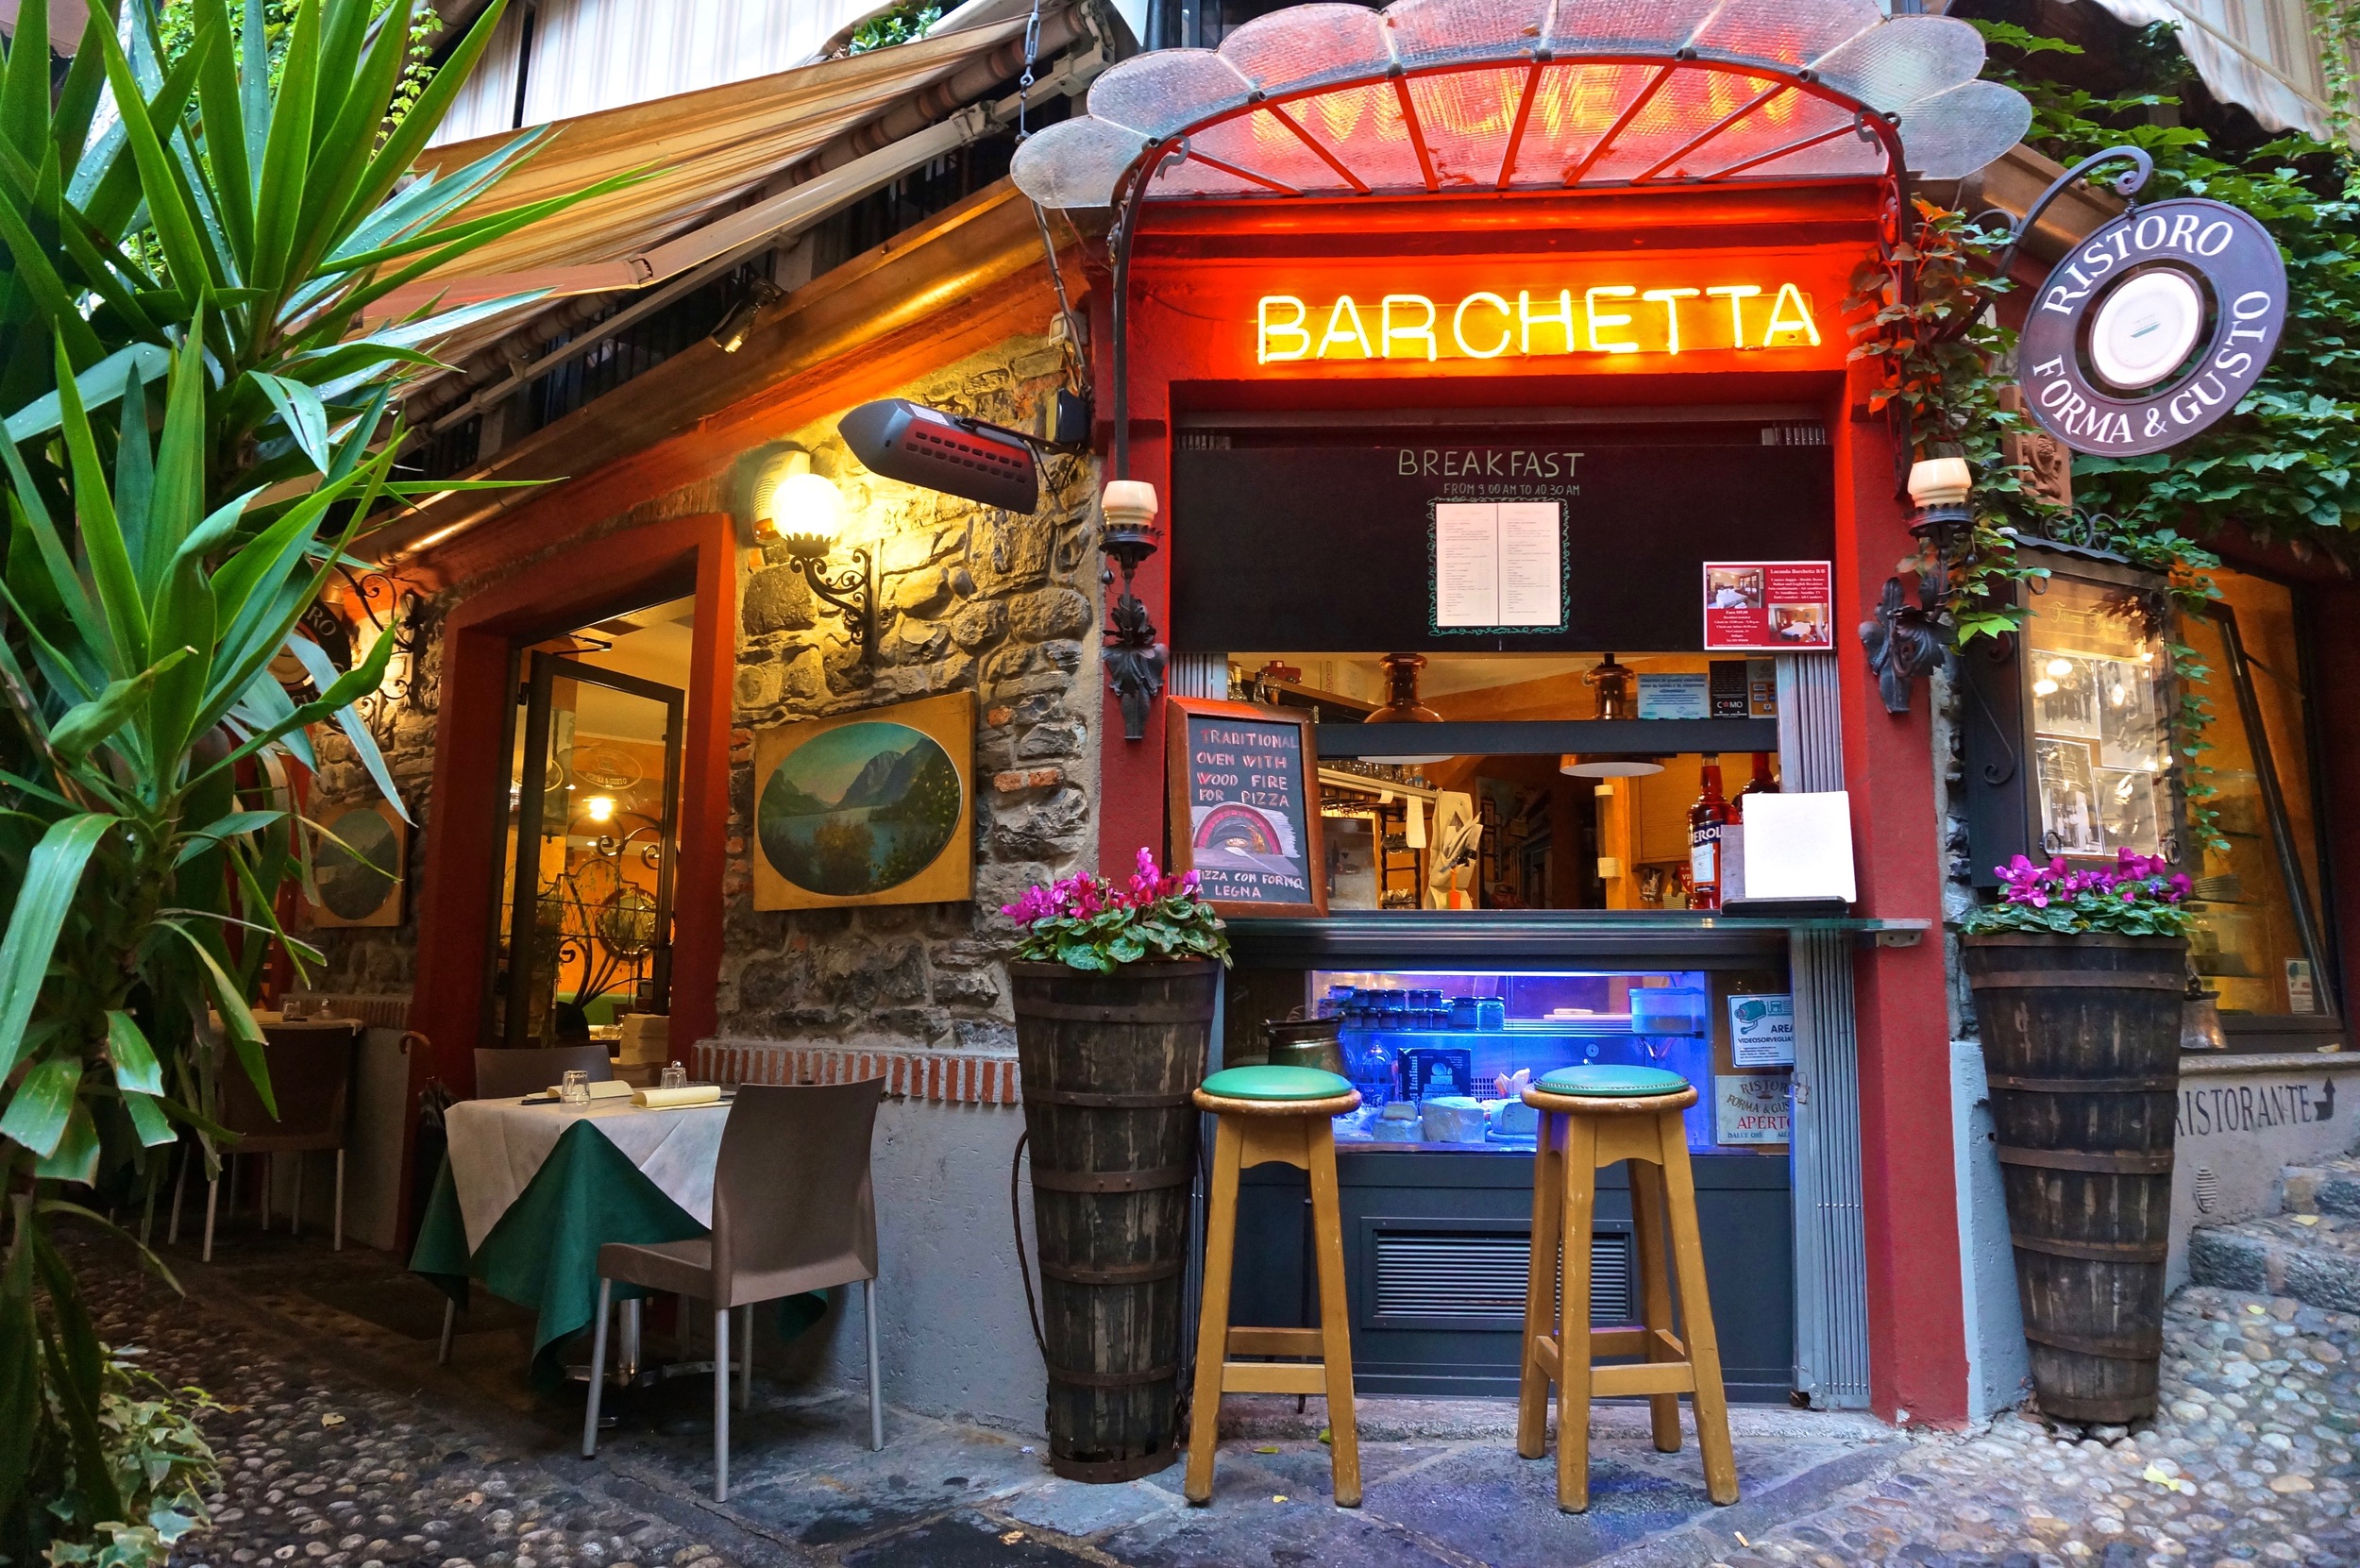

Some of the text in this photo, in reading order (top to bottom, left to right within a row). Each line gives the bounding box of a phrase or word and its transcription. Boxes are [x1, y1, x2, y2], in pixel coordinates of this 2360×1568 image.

[2042, 214, 2234, 315] RISTORO
[1256, 282, 1822, 365] BARCHETTA
[2032, 291, 2271, 443] FORMA & GUSTO
[1398, 448, 1585, 478] BREAKFAST
[1443, 482, 1475, 495] FROM
[1502, 483, 1517, 496] AM
[1519, 484, 1532, 496] TO
[1565, 484, 1580, 497] AM
[1201, 729, 1299, 749] TRADITIONAL
[1196, 751, 1288, 768] OVEN WITH
[1196, 772, 1289, 790] WOOD FIRE
[1199, 788, 1290, 807] FOR PIZZA
[1692, 826, 1722, 844] EROL
[1234, 872, 1257, 884] CON
[1215, 885, 1262, 898] LEGNA
[1740, 1079, 1789, 1095] RISTOR
[1727, 1093, 1790, 1115] FORMA & GUS
